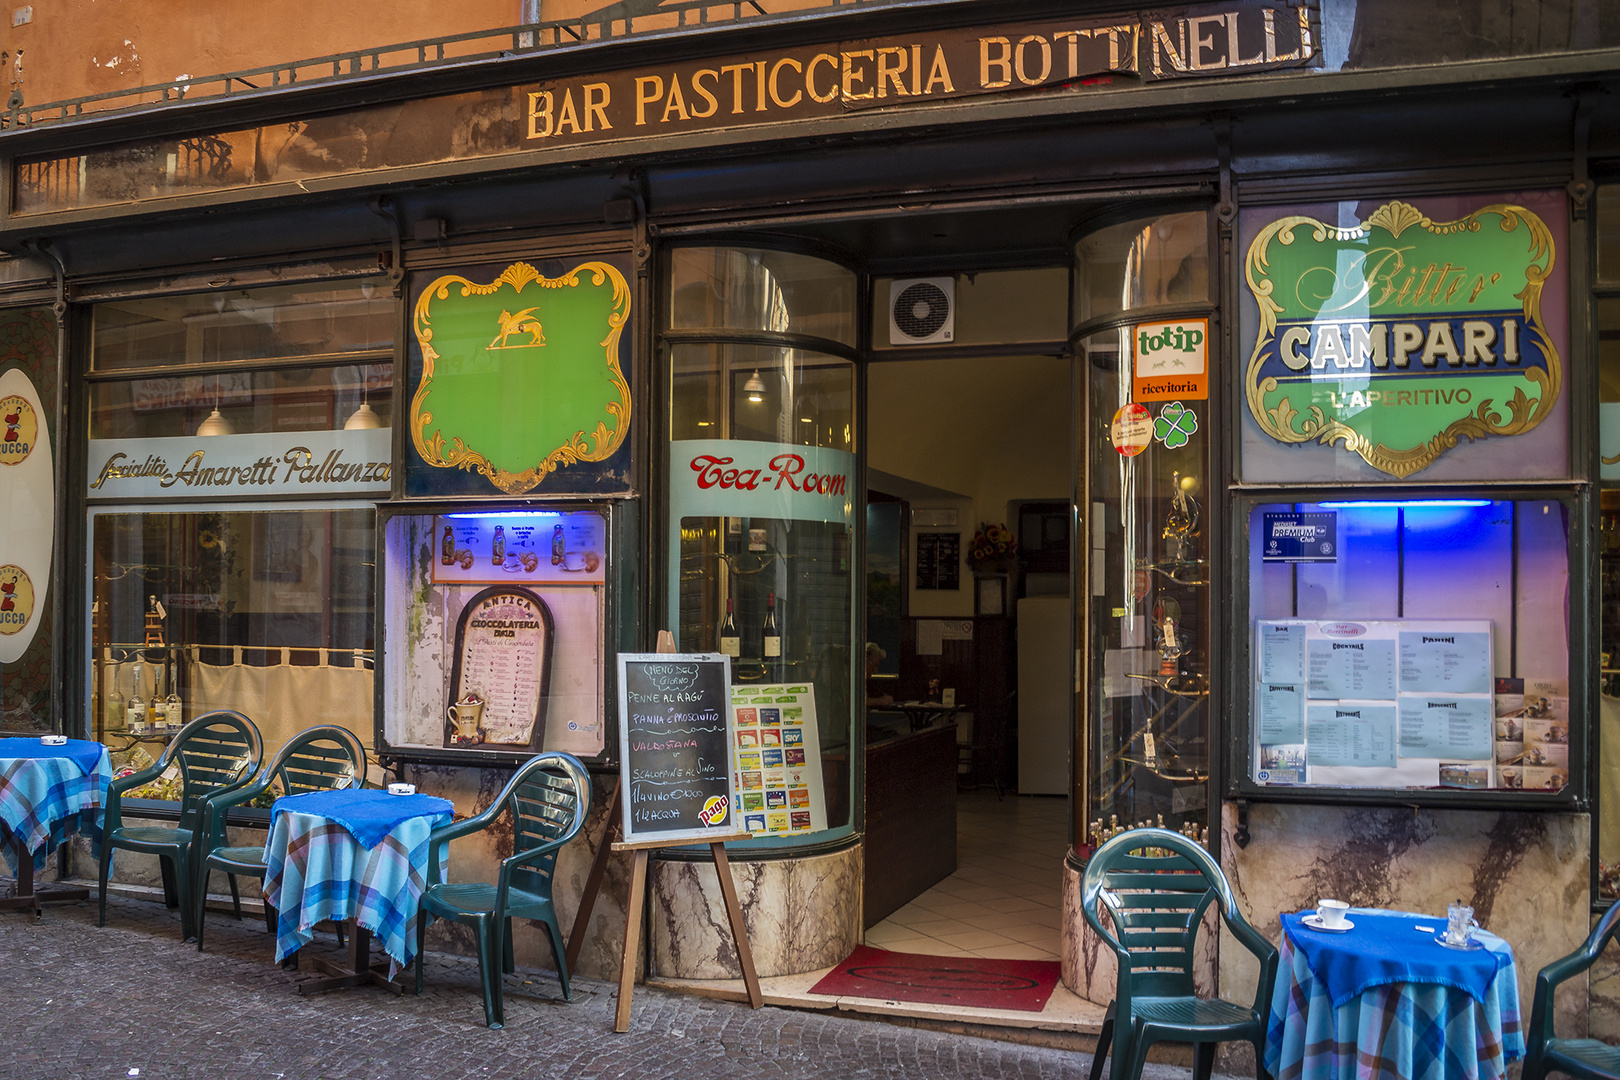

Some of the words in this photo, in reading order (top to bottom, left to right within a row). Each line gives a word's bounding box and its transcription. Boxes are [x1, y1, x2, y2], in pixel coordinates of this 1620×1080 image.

[526, 82, 613, 140] BAR
[634, 44, 955, 126] PASTICCERIA
[978, 5, 1316, 89] BOTTINELLI
[1296, 246, 1502, 313] Bitter
[1138, 326, 1204, 355] totip
[1280, 319, 1522, 371] CAMPARI
[1142, 381, 1198, 395] ricevitoria
[1331, 388, 1472, 408] L'APERITIVO
[0, 442, 29, 454] UCCA
[90, 452, 169, 490] Specialità
[160, 449, 282, 488] Amaretti
[283, 446, 392, 484] Pallanza
[690, 454, 846, 496] Tea-Room
[1273, 528, 1315, 537] PREMIUM
[483, 596, 531, 610] ANTICA
[471, 620, 540, 629] CIOCCOLATERIA
[1422, 636, 1455, 644] PANINI
[1332, 643, 1364, 651] COCKTAILS
[660, 676, 689, 685] GIORNO
[628, 691, 660, 703] PENNE
[663, 694, 675, 703] AL
[633, 713, 664, 725] PANNA
[785, 734, 800, 742] SKY
[633, 767, 683, 779] SCALOPPINE
[647, 793, 670, 801] VINO
[651, 808, 680, 821] ACQUA
[699, 796, 728, 828] pago
